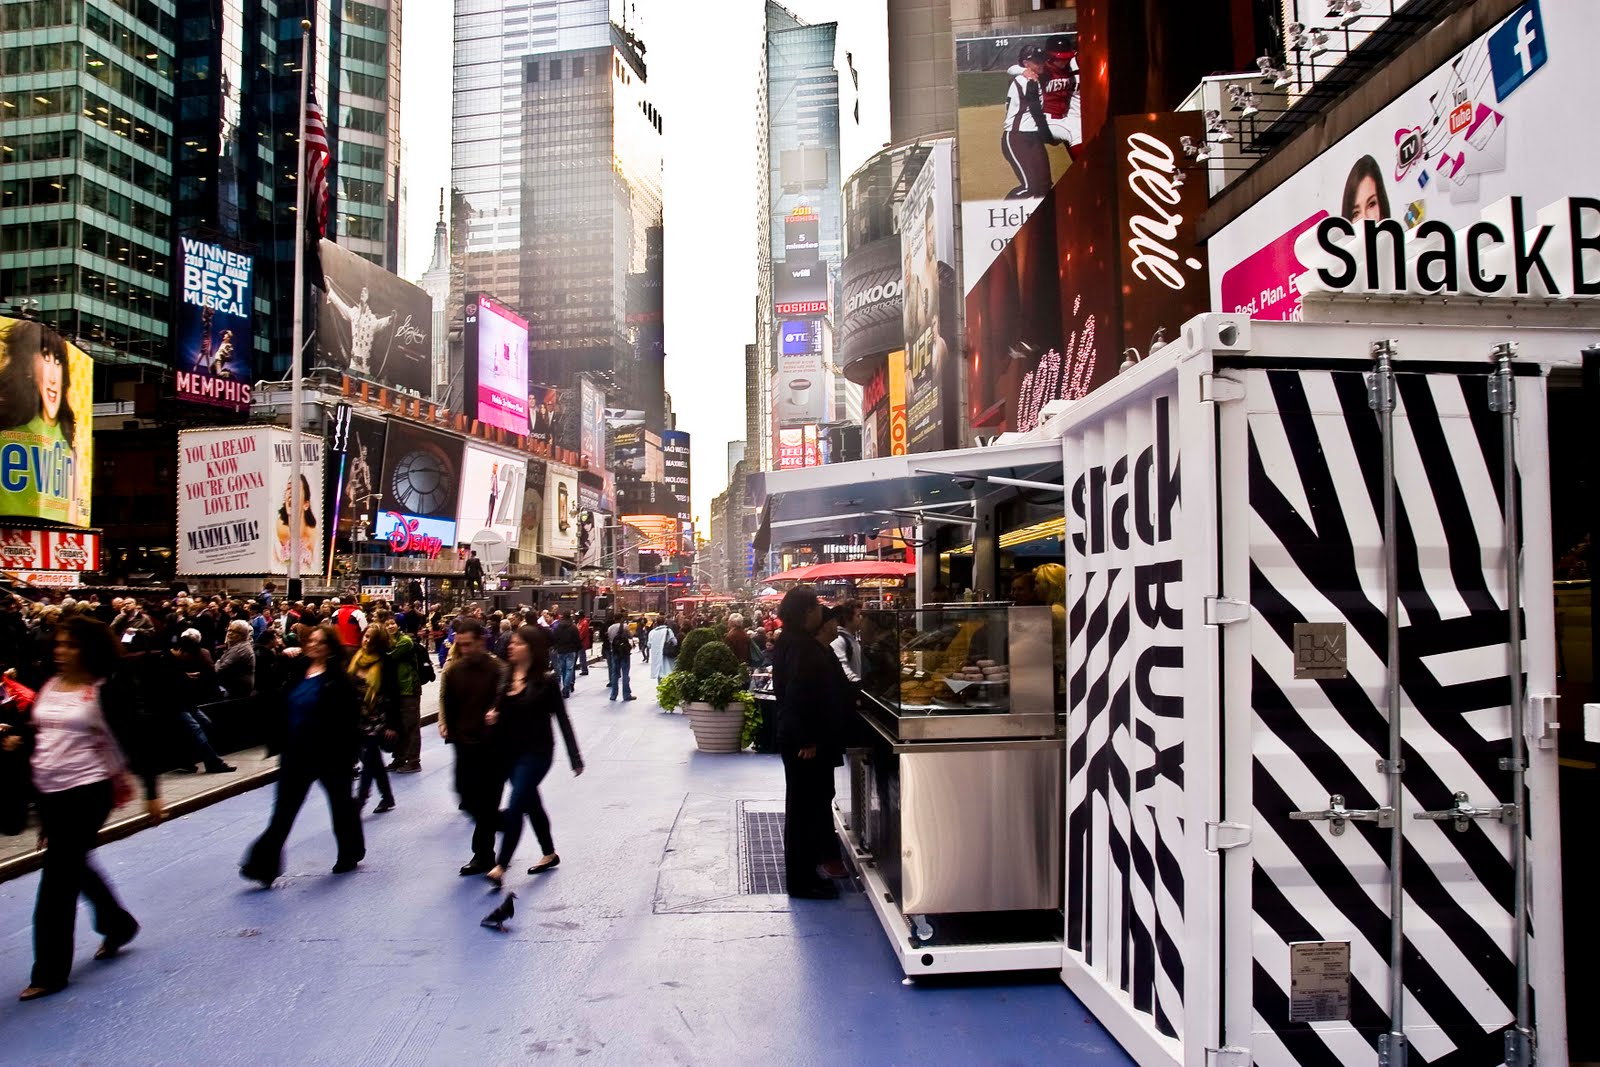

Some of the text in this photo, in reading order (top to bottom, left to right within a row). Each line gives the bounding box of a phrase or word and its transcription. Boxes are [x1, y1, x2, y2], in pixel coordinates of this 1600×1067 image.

[995, 39, 1009, 47] 215
[1452, 88, 1468, 107] You
[1451, 105, 1471, 130] Tube
[1403, 140, 1418, 159] TV
[785, 213, 819, 223] TOSHIBA
[792, 207, 812, 216] 2011
[1127, 132, 1202, 290] aerie
[785, 242, 819, 250] minutes
[798, 233, 806, 242] 5
[181, 236, 252, 272] WINNER!
[184, 264, 249, 303] BEST
[792, 268, 811, 278] will
[183, 289, 249, 318] MUSICAL
[775, 302, 827, 313] TOSHIBA
[1260, 285, 1287, 310] Plan.
[912, 326, 933, 379] UFC
[176, 371, 251, 404] MEMPHIS
[185, 435, 257, 464] YOU ALREADY
[206, 457, 239, 478] KNOW
[185, 471, 264, 500] YOU'RE GONNA
[203, 491, 250, 516] LOVE IT!
[187, 526, 232, 551] MAMMA
[232, 520, 260, 544] MIA!
